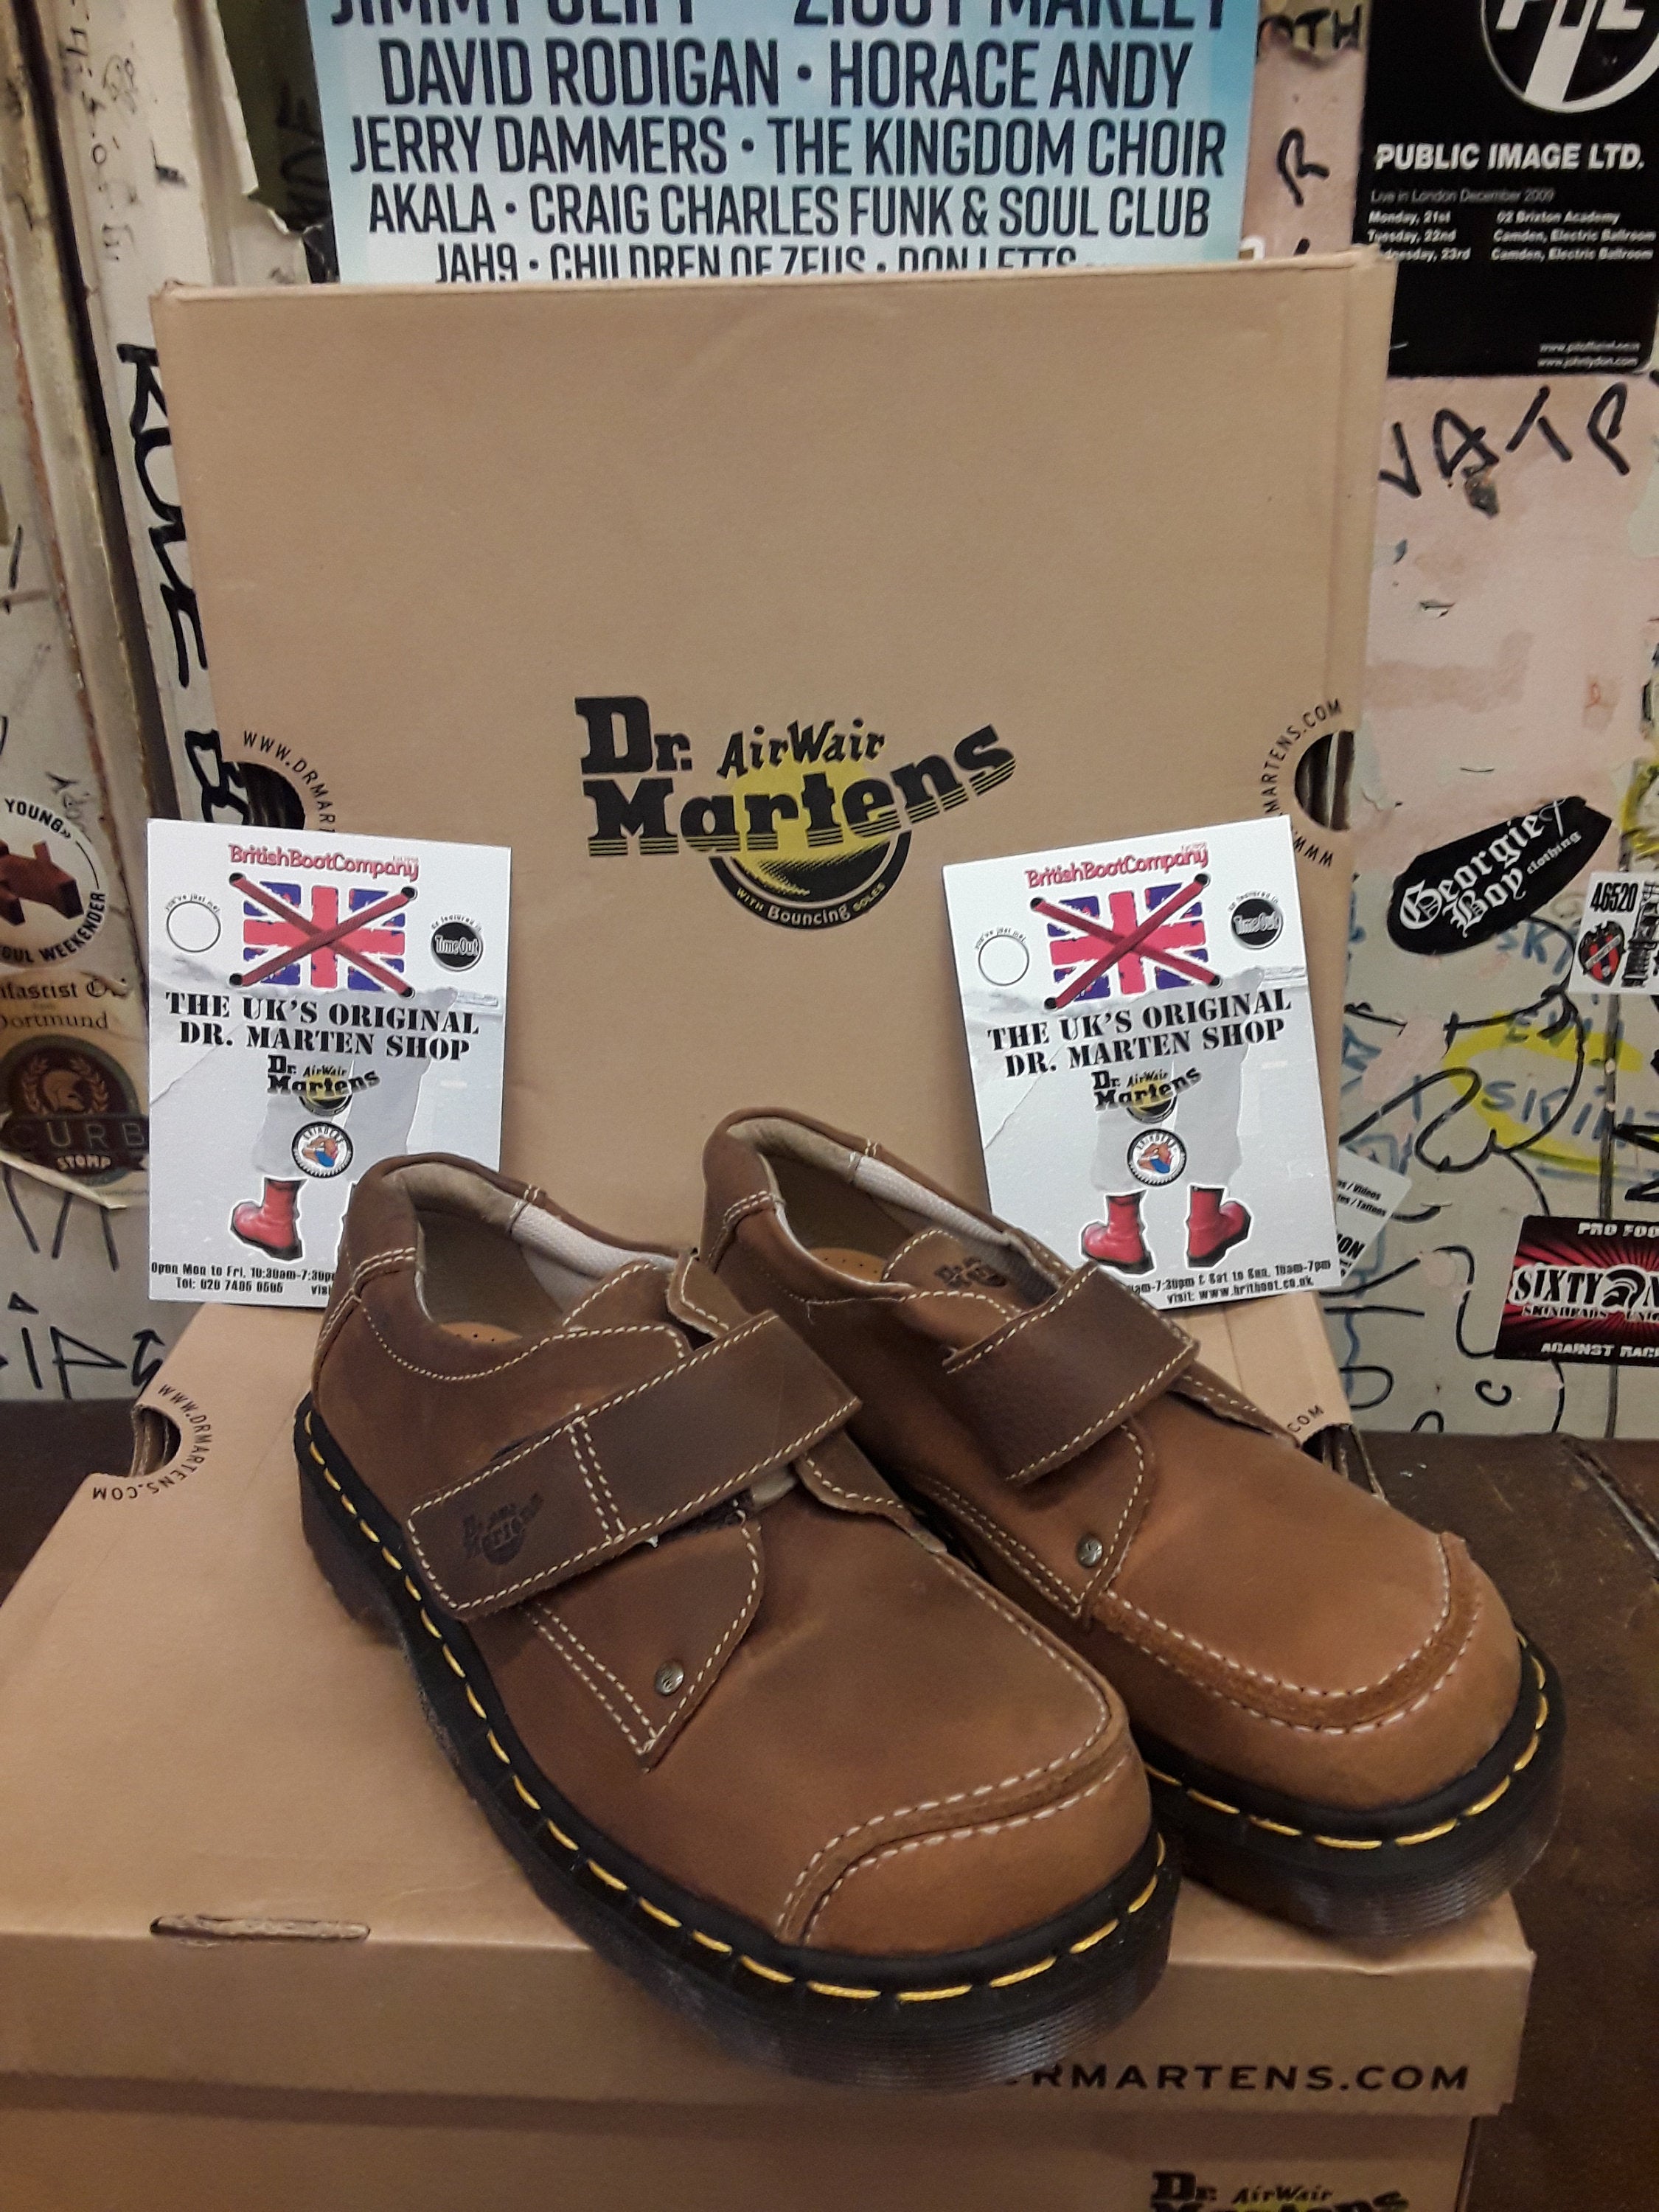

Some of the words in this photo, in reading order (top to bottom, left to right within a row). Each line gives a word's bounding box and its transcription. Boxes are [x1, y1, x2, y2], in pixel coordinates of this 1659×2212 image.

[379, 38, 532, 106] DAVID
[546, 38, 779, 108] RODIGAN
[830, 40, 1039, 108] HORACE
[1049, 41, 1192, 109] ANDY
[350, 116, 482, 174] JERRY
[495, 116, 727, 175] DAMMERS
[768, 116, 852, 176] THE
[865, 117, 1074, 177] KINGDOM
[1088, 119, 1225, 178] CHOIR
[1375, 144, 1480, 170] PUBLIC
[1488, 144, 1581, 170] IMAGE
[1588, 144, 1645, 170] LTD.
[369, 184, 496, 234] AKALA
[529, 184, 650, 234] CRAIG
[661, 184, 839, 236] CHARLES
[850, 185, 953, 237] FUNK
[962, 186, 988, 237] &
[998, 187, 1099, 237] SOUL
[1109, 187, 1211, 238] CLUB
[1411, 189, 1458, 203] London
[1368, 210, 1420, 226] Monday,
[1516, 210, 1562, 223] Brixton
[1563, 209, 1621, 226] Academy
[1367, 229, 1422, 244] Tuesday,
[1424, 229, 1457, 243] 22nd
[1493, 228, 1548, 243] Camden,
[1550, 228, 1599, 242] Electric
[1600, 228, 1657, 242] Ballroom
[1383, 247, 1437, 263] dnesday,
[1441, 246, 1472, 261] 23rd
[1491, 246, 1545, 262] Camden,
[1548, 246, 1596, 260] Electric
[1598, 246, 1655, 260] Ballroom
[575, 695, 692, 775] Dr.
[716, 717, 886, 779] AirWair
[582, 723, 1017, 858] Martens
[229, 844, 420, 883] BritishBootCompany
[1025, 848, 1208, 889] BritishBootCompany
[1399, 814, 1545, 930] Georgie
[1442, 868, 1527, 939] Boy
[1526, 831, 1582, 874] clothing
[1590, 882, 1639, 913] 46520
[735, 886, 765, 913] WITH
[767, 904, 851, 927] Bouncing
[39, 891, 105, 962] WEEKENDER
[165, 991, 230, 1018] THE
[243, 997, 318, 1024] UK'S
[329, 1003, 479, 1035] ORIGINAL
[987, 1021, 1049, 1052] THE
[1060, 1009, 1133, 1043] UK'S
[1142, 988, 1292, 1030] ORIGINAL
[179, 1021, 234, 1046] DR.
[246, 1025, 373, 1055] MARTEN
[386, 1036, 470, 1062] SHOP
[1005, 1052, 1057, 1078] DR.
[1068, 1030, 1192, 1069] MARTEN
[1202, 1018, 1286, 1051] SHOP
[268, 1054, 296, 1074] Dr.
[303, 1065, 347, 1077] AirWair
[267, 1070, 380, 1096] Martens
[1091, 1070, 1121, 1091] Dr.
[1093, 1067, 1203, 1111] Martens
[57, 1154, 111, 1171] STOMP
[1577, 1222, 1618, 1237] PRO
[151, 1262, 178, 1276] Open
[183, 1263, 206, 1276] Mon
[211, 1265, 222, 1276] to
[176, 1276, 195, 1290] Tel:
[200, 1279, 221, 1290] 020
[1208, 1273, 1228, 1284] Sat
[1232, 1270, 1244, 1281] to
[1514, 1269, 1604, 1305] SIXTY
[1540, 1342, 1615, 1357] AGAINST
[92, 1383, 212, 1500] WWW.DRMARTENS.COM
[1006, 2064, 1468, 2091] RMARTENS.COM
[1150, 2170, 1217, 2202] Dr.
[1231, 2183, 1334, 2205] AirWair
